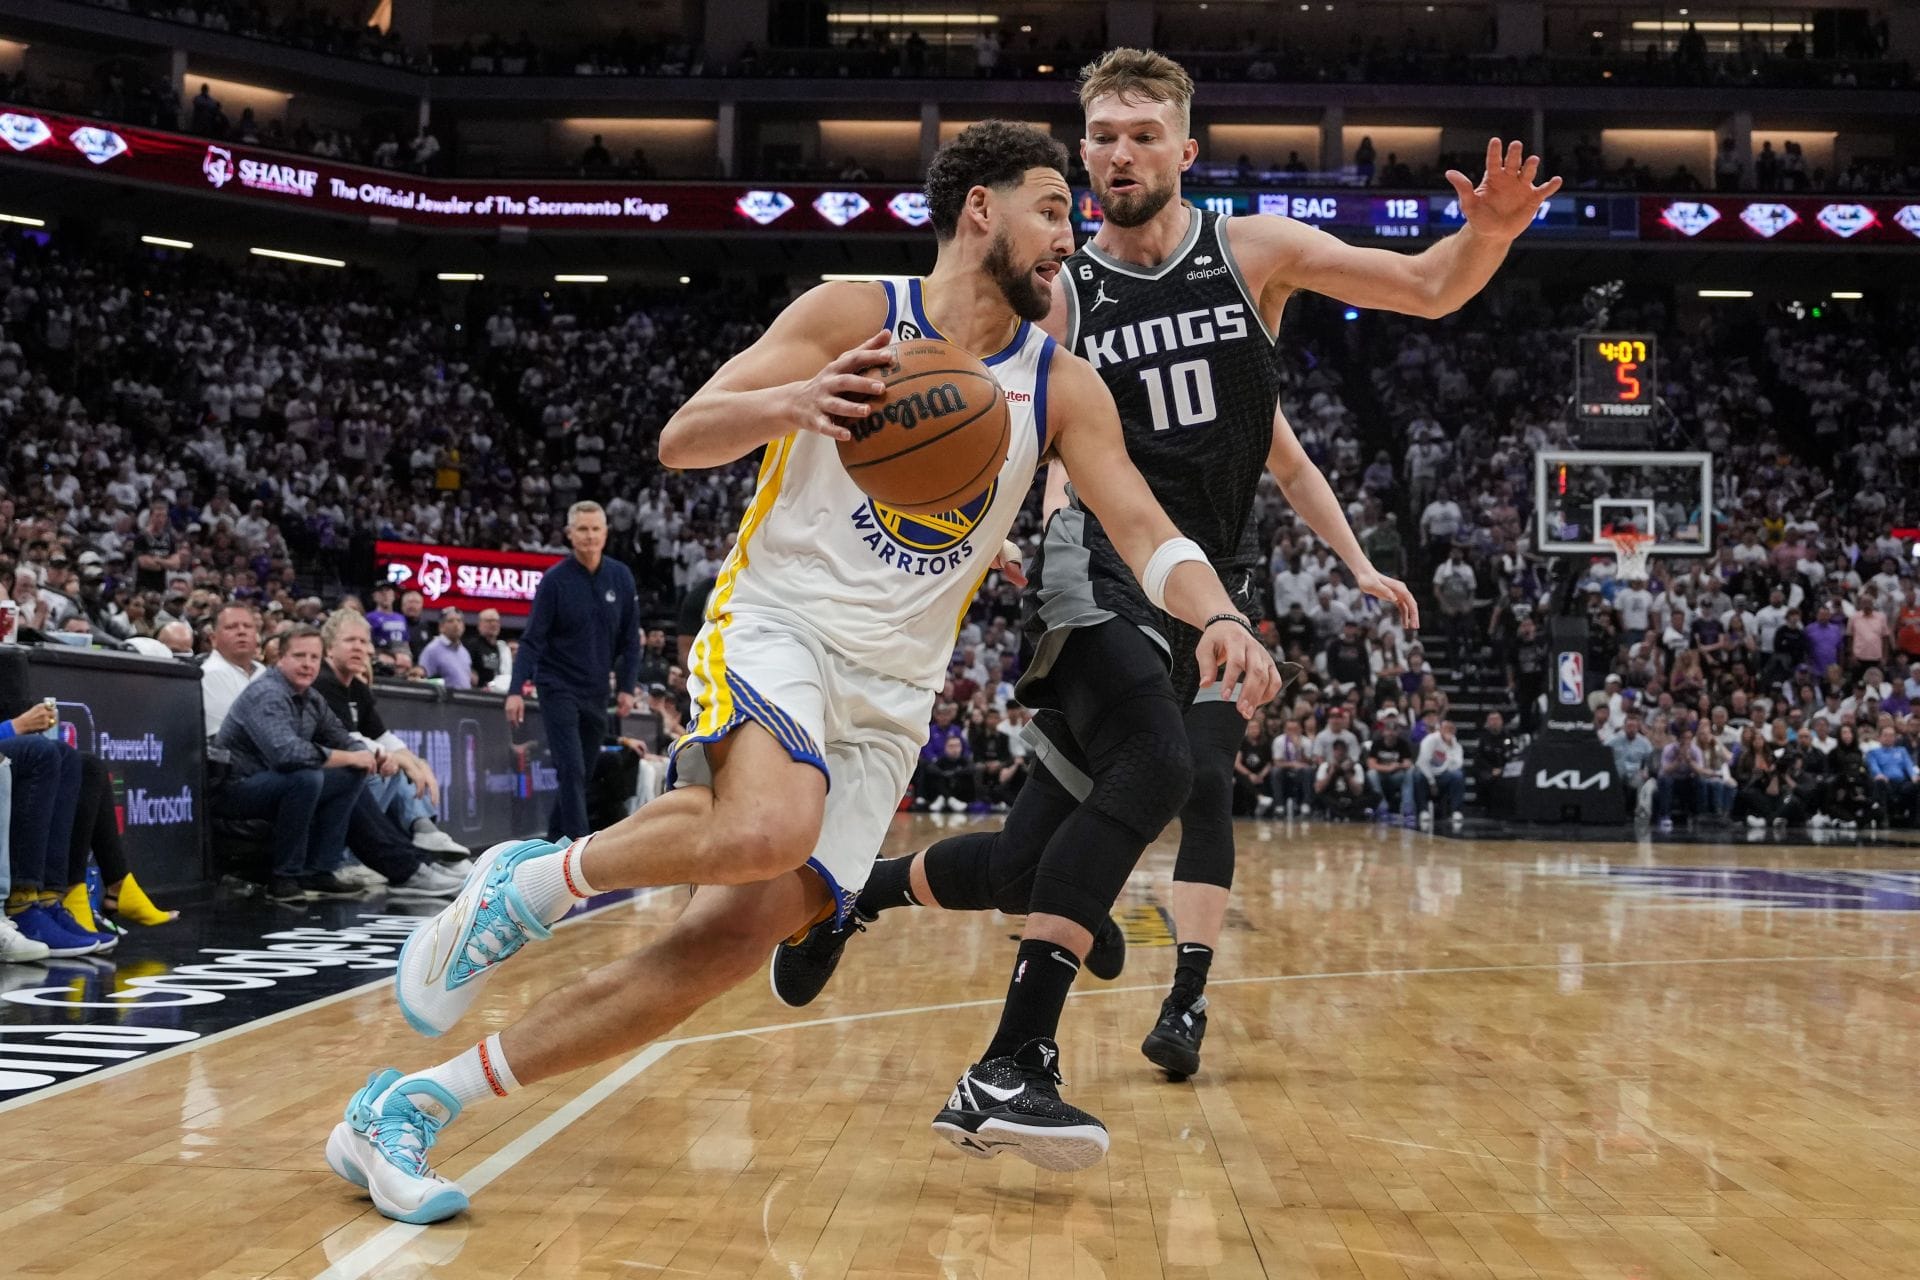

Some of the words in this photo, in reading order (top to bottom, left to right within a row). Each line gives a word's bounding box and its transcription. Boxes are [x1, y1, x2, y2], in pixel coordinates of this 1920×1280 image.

[239, 159, 318, 190] SHARIF
[329, 178, 358, 200] The
[359, 183, 415, 209] Official
[415, 193, 473, 214] Jeweler
[474, 196, 493, 214] of
[494, 196, 525, 215] The
[528, 196, 621, 216] Sacramento
[624, 197, 669, 222] Kings
[1205, 198, 1233, 216] 111
[1292, 198, 1337, 219] SAC
[1385, 199, 1419, 219] 112
[1079, 264, 1094, 281] 6
[1186, 264, 1228, 282] dialpad
[1084, 304, 1248, 369] KINGS
[1600, 341, 1646, 363] 4:07
[1140, 359, 1217, 431] 10
[1616, 362, 1641, 400] 5
[850, 382, 968, 443] Wilson
[1603, 404, 1651, 416] TISSOT
[851, 502, 973, 577] WARRIORS
[100, 732, 150, 761] Powered
[150, 733, 163, 767] by
[127, 785, 193, 826] Microsoft
